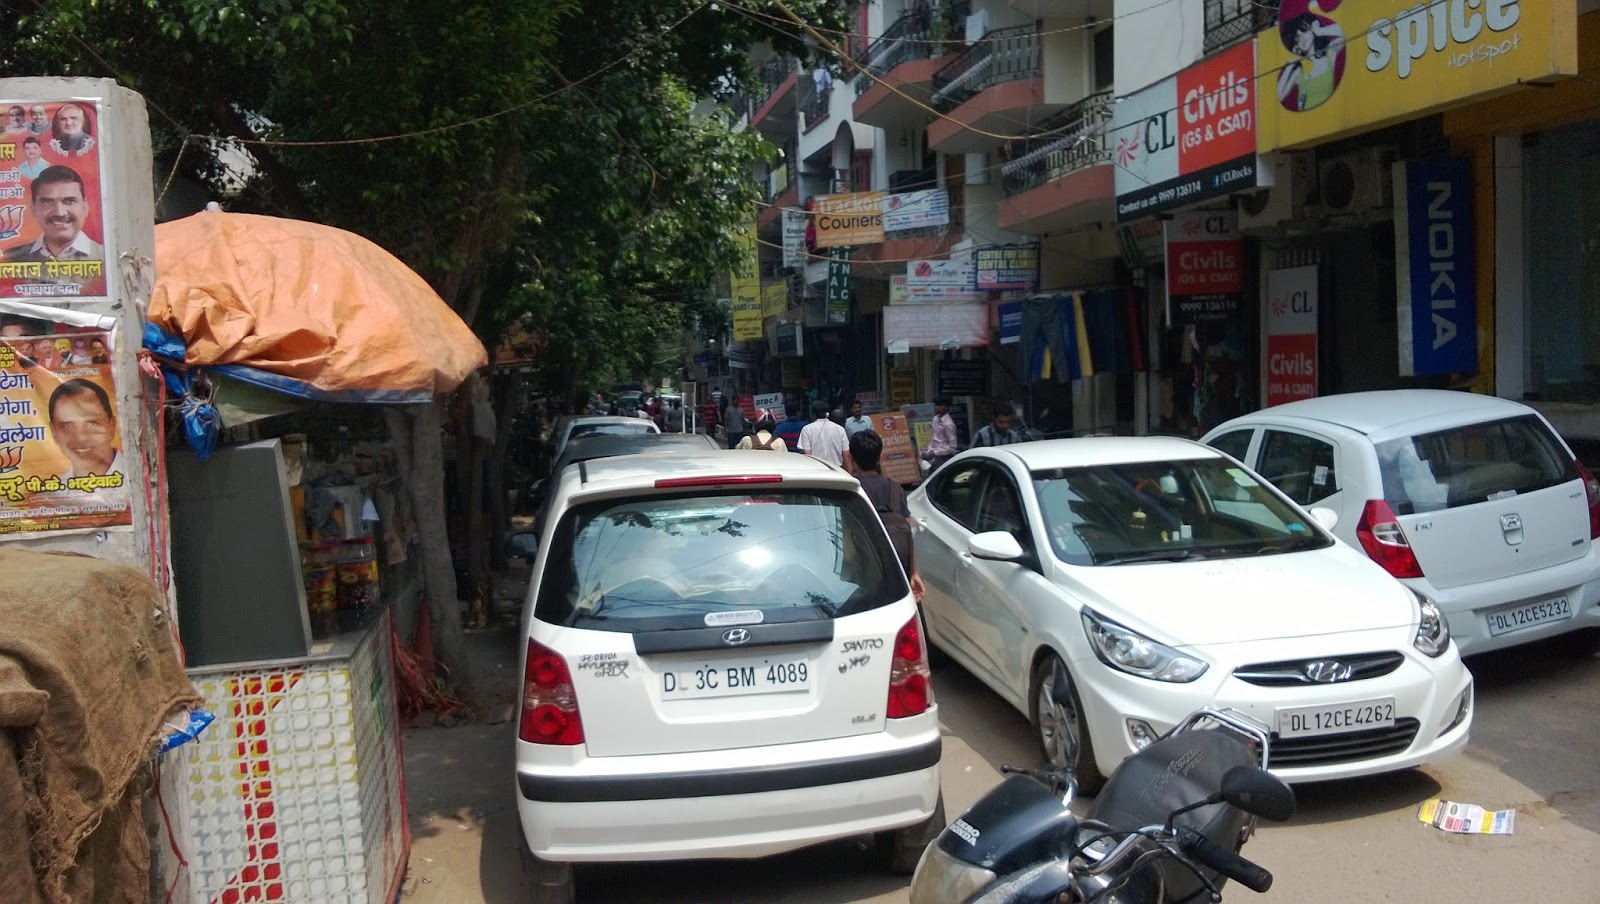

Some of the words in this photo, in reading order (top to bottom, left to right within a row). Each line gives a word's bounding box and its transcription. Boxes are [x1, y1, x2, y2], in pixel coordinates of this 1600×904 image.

[1184, 71, 1249, 124] Civils
[1145, 112, 1175, 154] CL
[1205, 124, 1215, 142] &
[1217, 109, 1251, 137] CSAT)
[819, 215, 882, 230] Couriers
[1179, 250, 1235, 271] Civils
[1427, 181, 1457, 351] NOKIA
[1291, 291, 1313, 314] CL
[1270, 352, 1314, 376] Civils
[882, 434, 911, 446] rackon
[1496, 600, 1569, 630] DL12CE5232
[841, 638, 884, 654] SANTRO
[696, 669, 720, 690] 3C
[728, 666, 756, 688] BM
[766, 662, 809, 685] 4089
[1291, 704, 1393, 732] DL12CE4262
